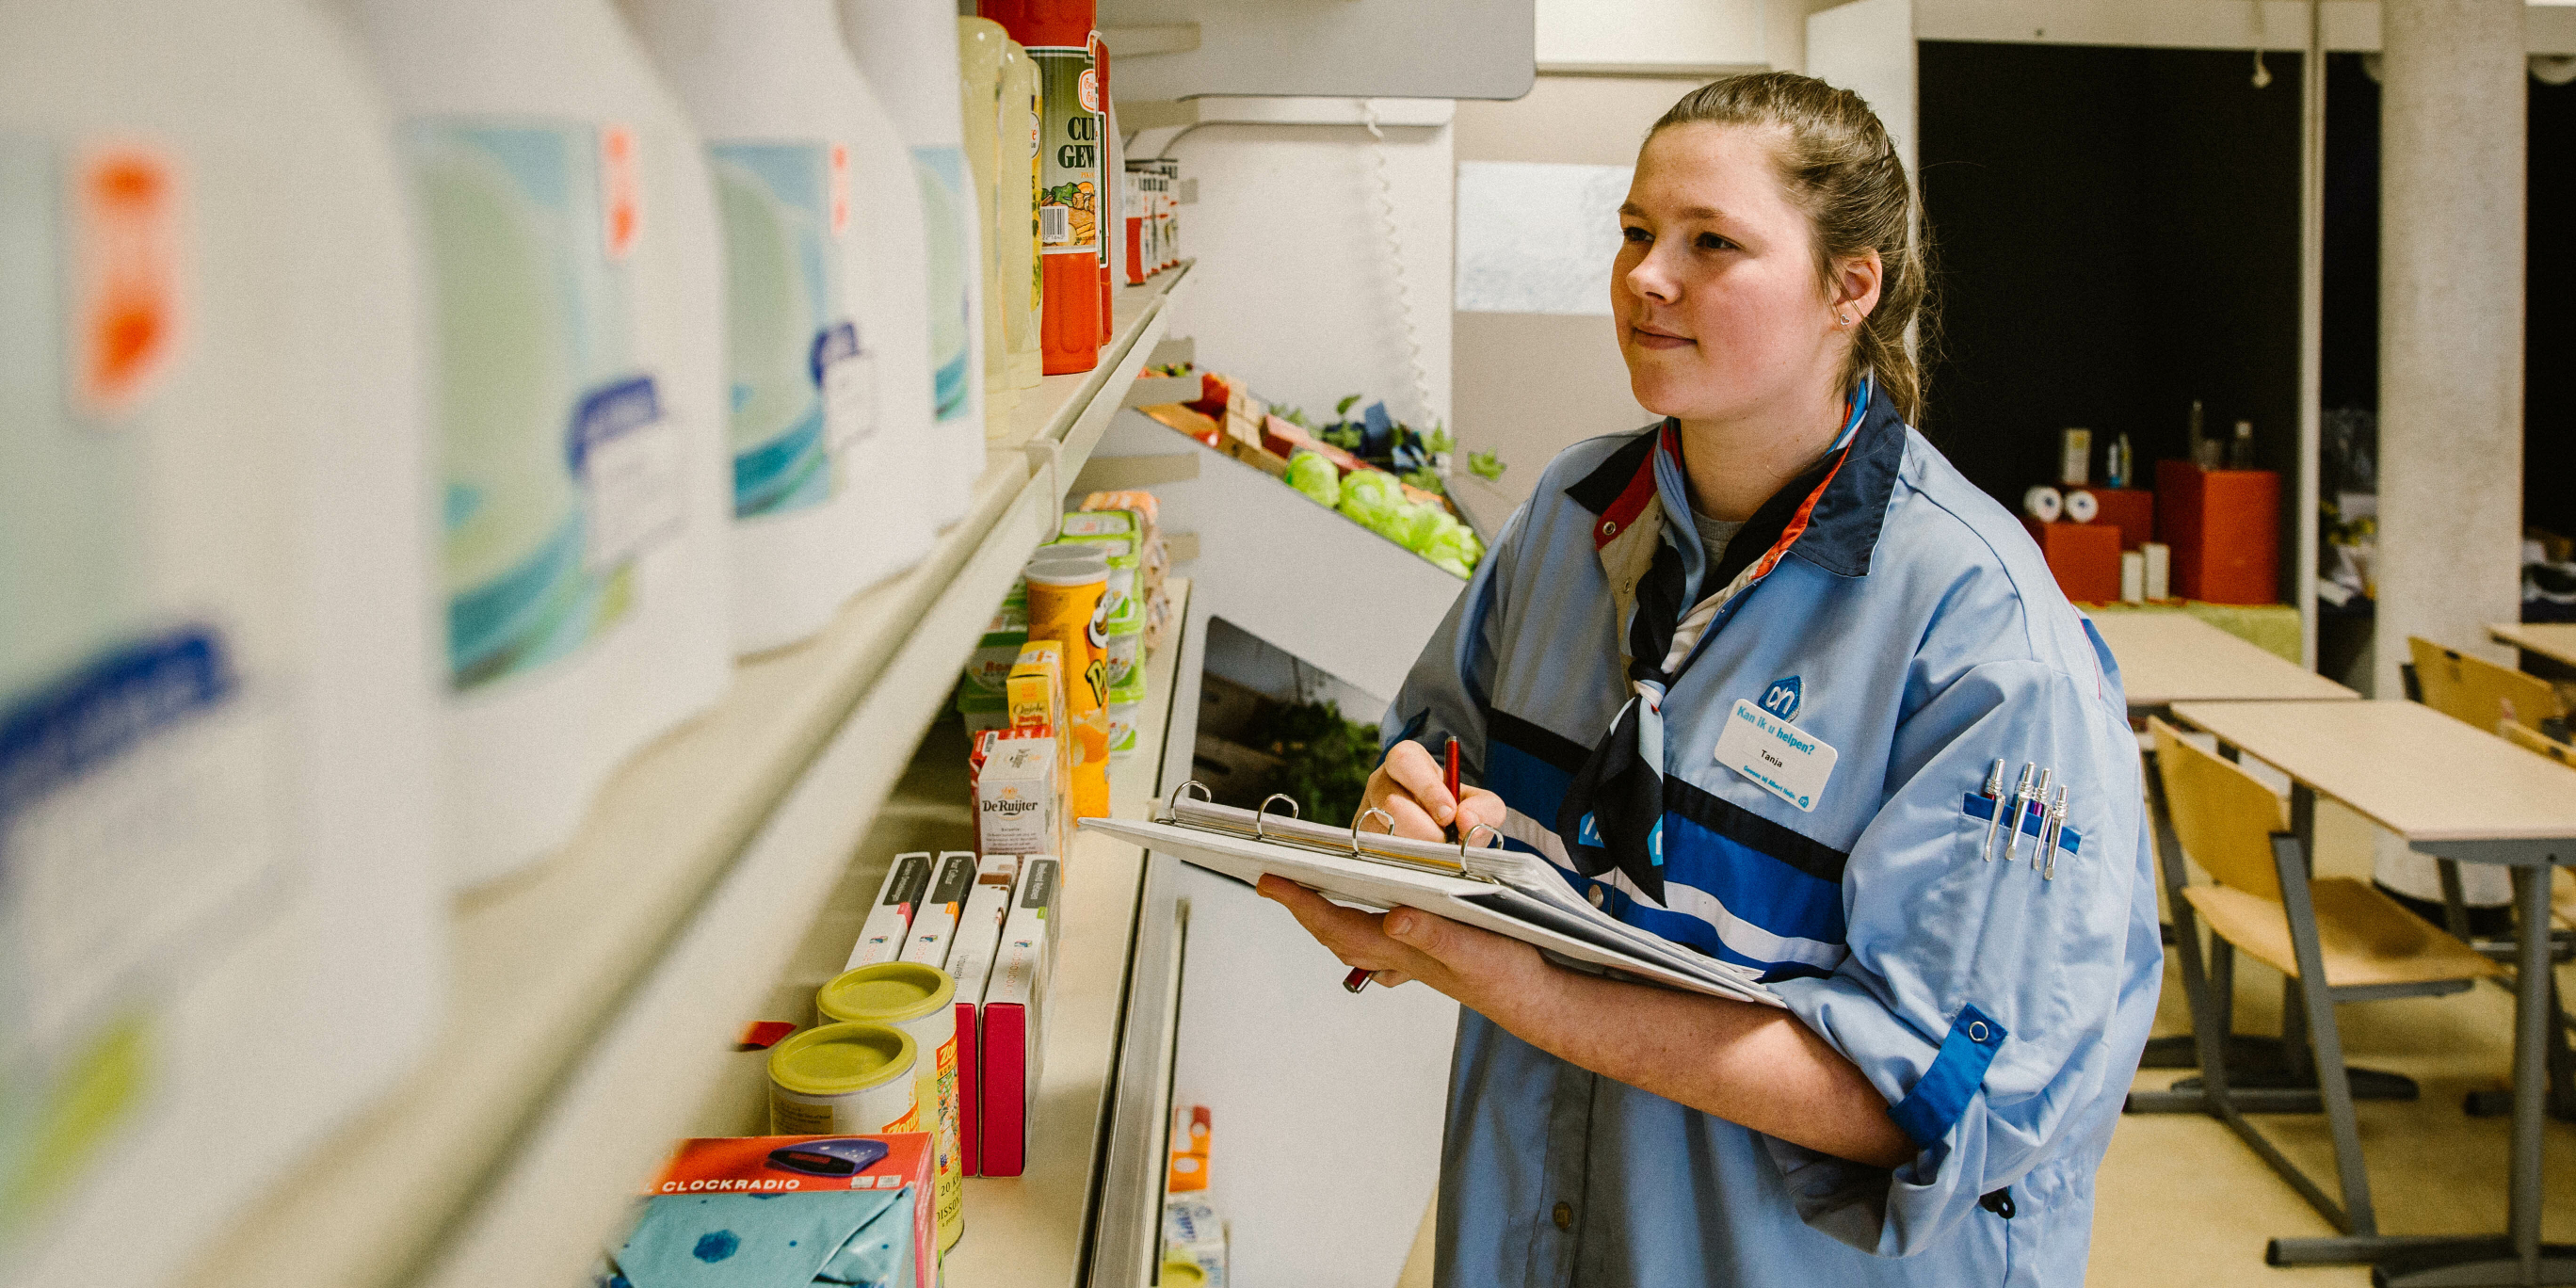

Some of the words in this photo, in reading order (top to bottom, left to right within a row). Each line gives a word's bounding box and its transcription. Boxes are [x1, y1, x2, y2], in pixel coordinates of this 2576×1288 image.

[1737, 706, 1756, 723] Kan
[1757, 716, 1767, 730] ik
[1767, 725, 1776, 734] u
[1776, 727, 1815, 755] helpen?
[1761, 749, 1782, 768] Tanja
[1768, 780, 1782, 792] Albert
[982, 800, 997, 813] De
[998, 799, 1038, 816] Ruijter
[1003, 947, 1023, 996] cadeaubox.nl
[662, 1179, 801, 1192] CLOCKRADIO
[941, 1182, 950, 1197] 20
